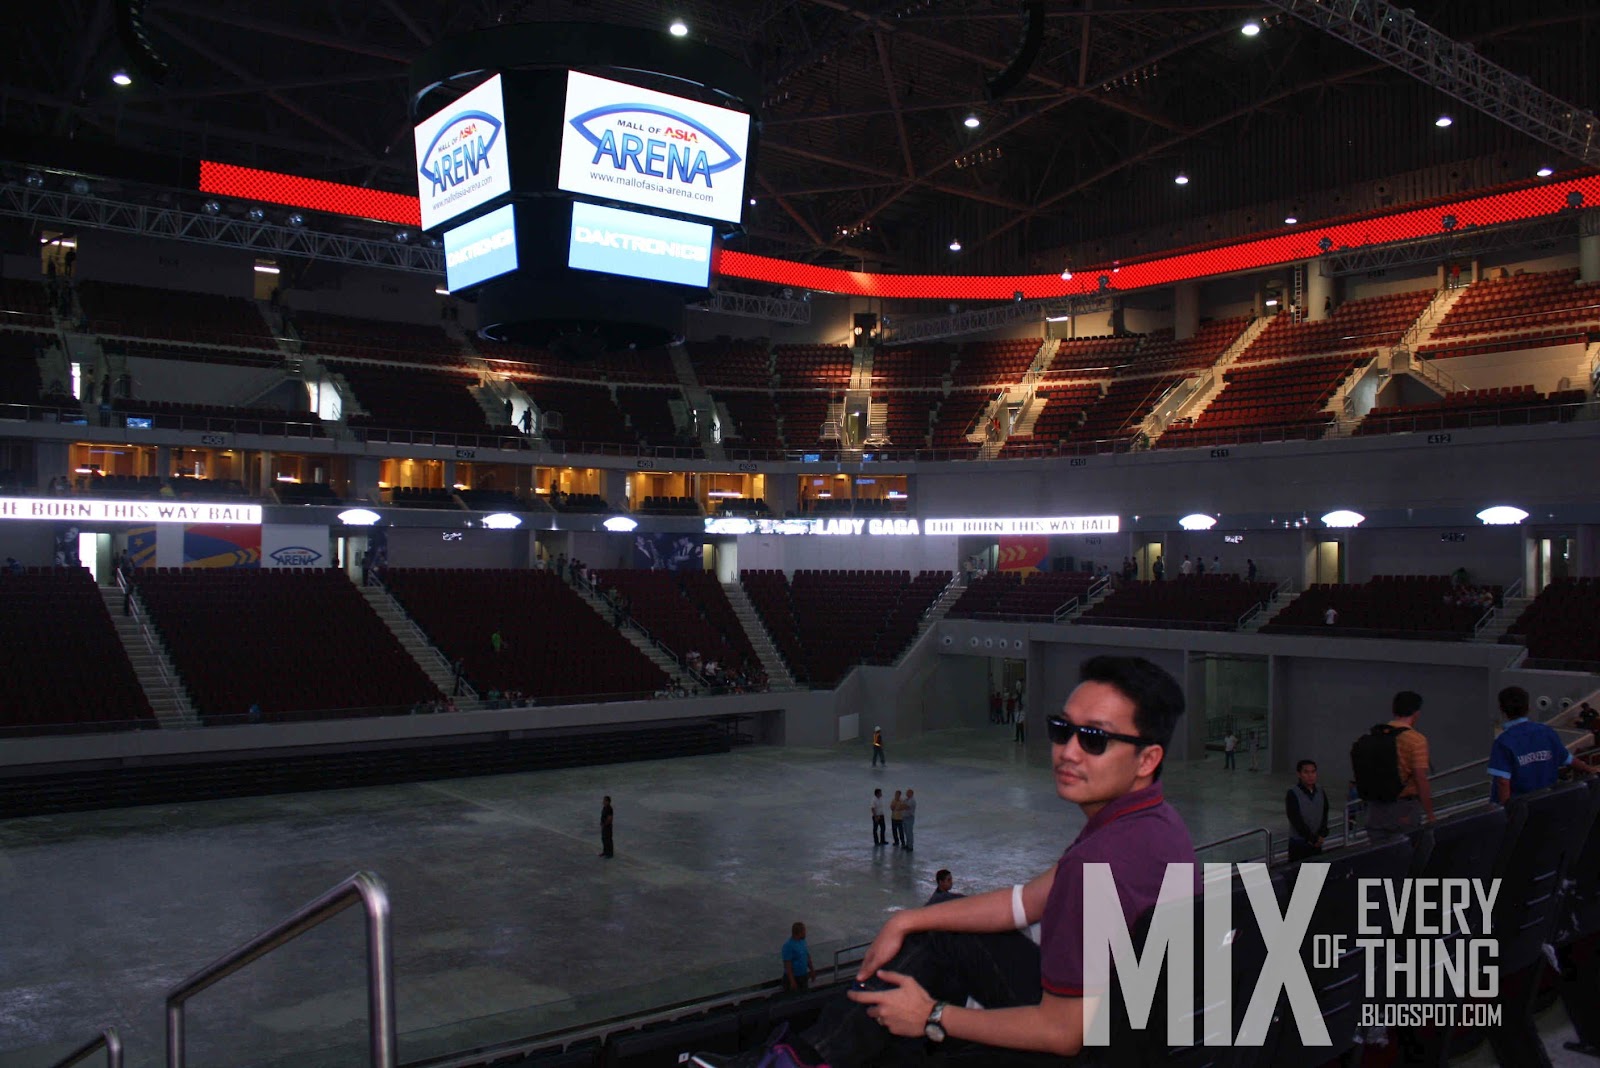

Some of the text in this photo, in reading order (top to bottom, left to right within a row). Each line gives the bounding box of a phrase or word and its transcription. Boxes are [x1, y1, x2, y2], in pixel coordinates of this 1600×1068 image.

[459, 123, 478, 140] ASIA
[617, 119, 699, 144] MALL OF ASIA
[432, 135, 490, 197] ARENA
[592, 129, 713, 188] ARENA
[589, 170, 714, 202] www.mallofasia-arena.com
[575, 226, 707, 262] DAKTRONICS
[1428, 434, 1450, 444] 412
[456, 450, 475, 459] 407
[32, 502, 92, 517] BORN
[104, 503, 149, 519] THIS
[158, 505, 200, 520] WAY
[814, 518, 865, 535] LADY
[869, 518, 920, 535] GAGA
[931, 521, 954, 531] THE
[1011, 520, 1044, 531] THIS
[1049, 519, 1075, 530] WAY
[276, 555, 315, 565] ARENA
